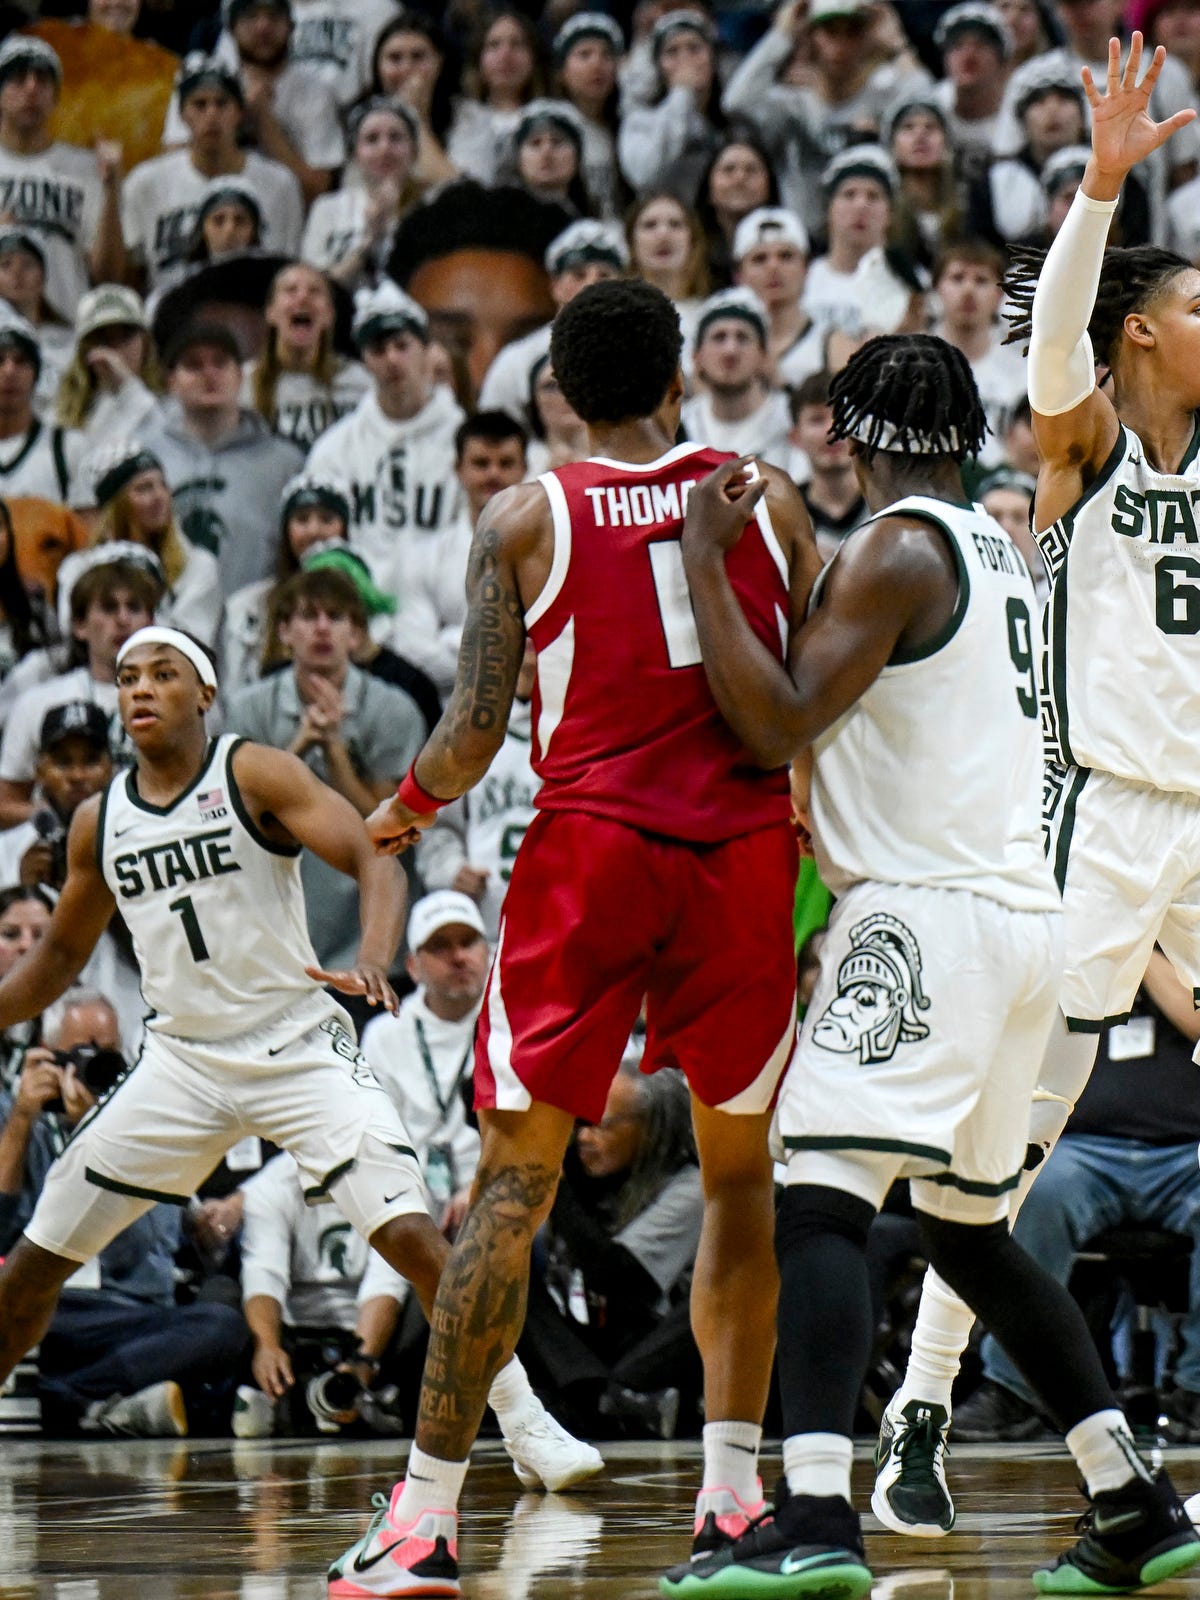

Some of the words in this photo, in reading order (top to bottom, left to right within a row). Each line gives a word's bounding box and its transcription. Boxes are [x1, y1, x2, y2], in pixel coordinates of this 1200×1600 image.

[351, 480, 443, 530] MSU
[1005, 596, 1038, 719] 9
[114, 827, 242, 899] STATE
[169, 895, 210, 963] 1
